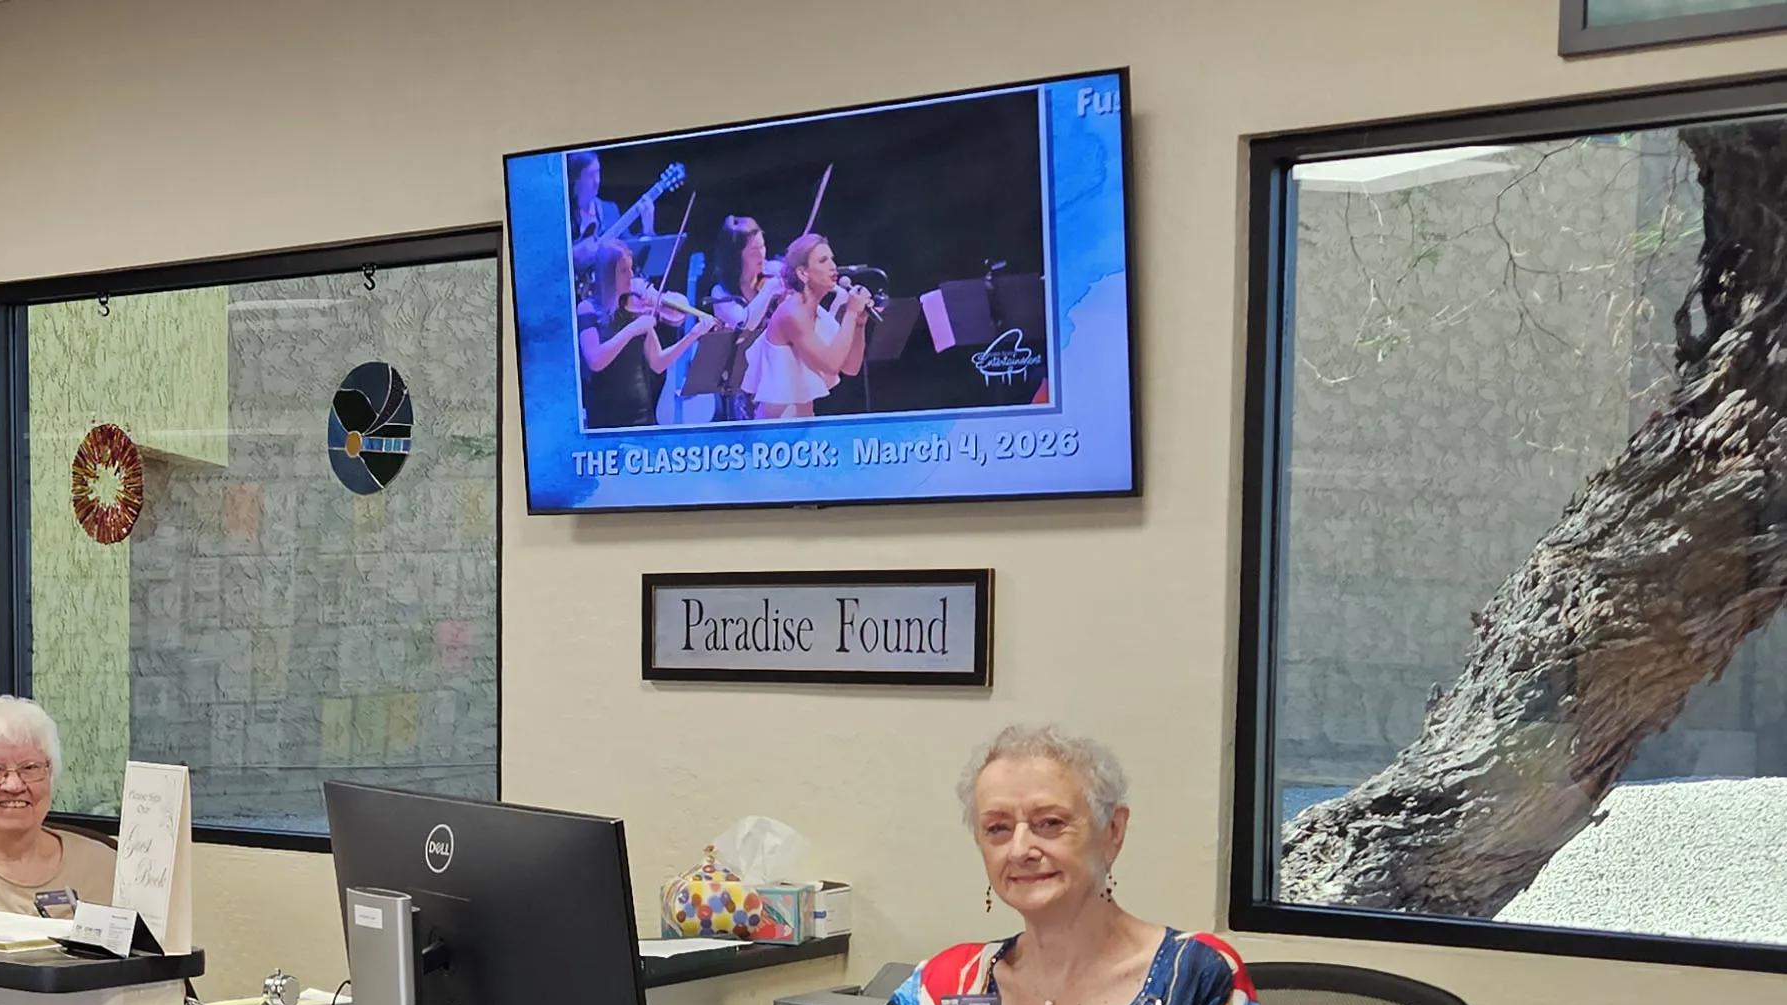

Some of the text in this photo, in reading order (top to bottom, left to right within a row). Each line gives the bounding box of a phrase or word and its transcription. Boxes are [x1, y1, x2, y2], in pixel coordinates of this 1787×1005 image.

[572, 427, 1080, 476] THE CLASSICS ROCK: March 4, 2026
[681, 596, 949, 655] Paradise Found
[428, 840, 450, 856] DELL
